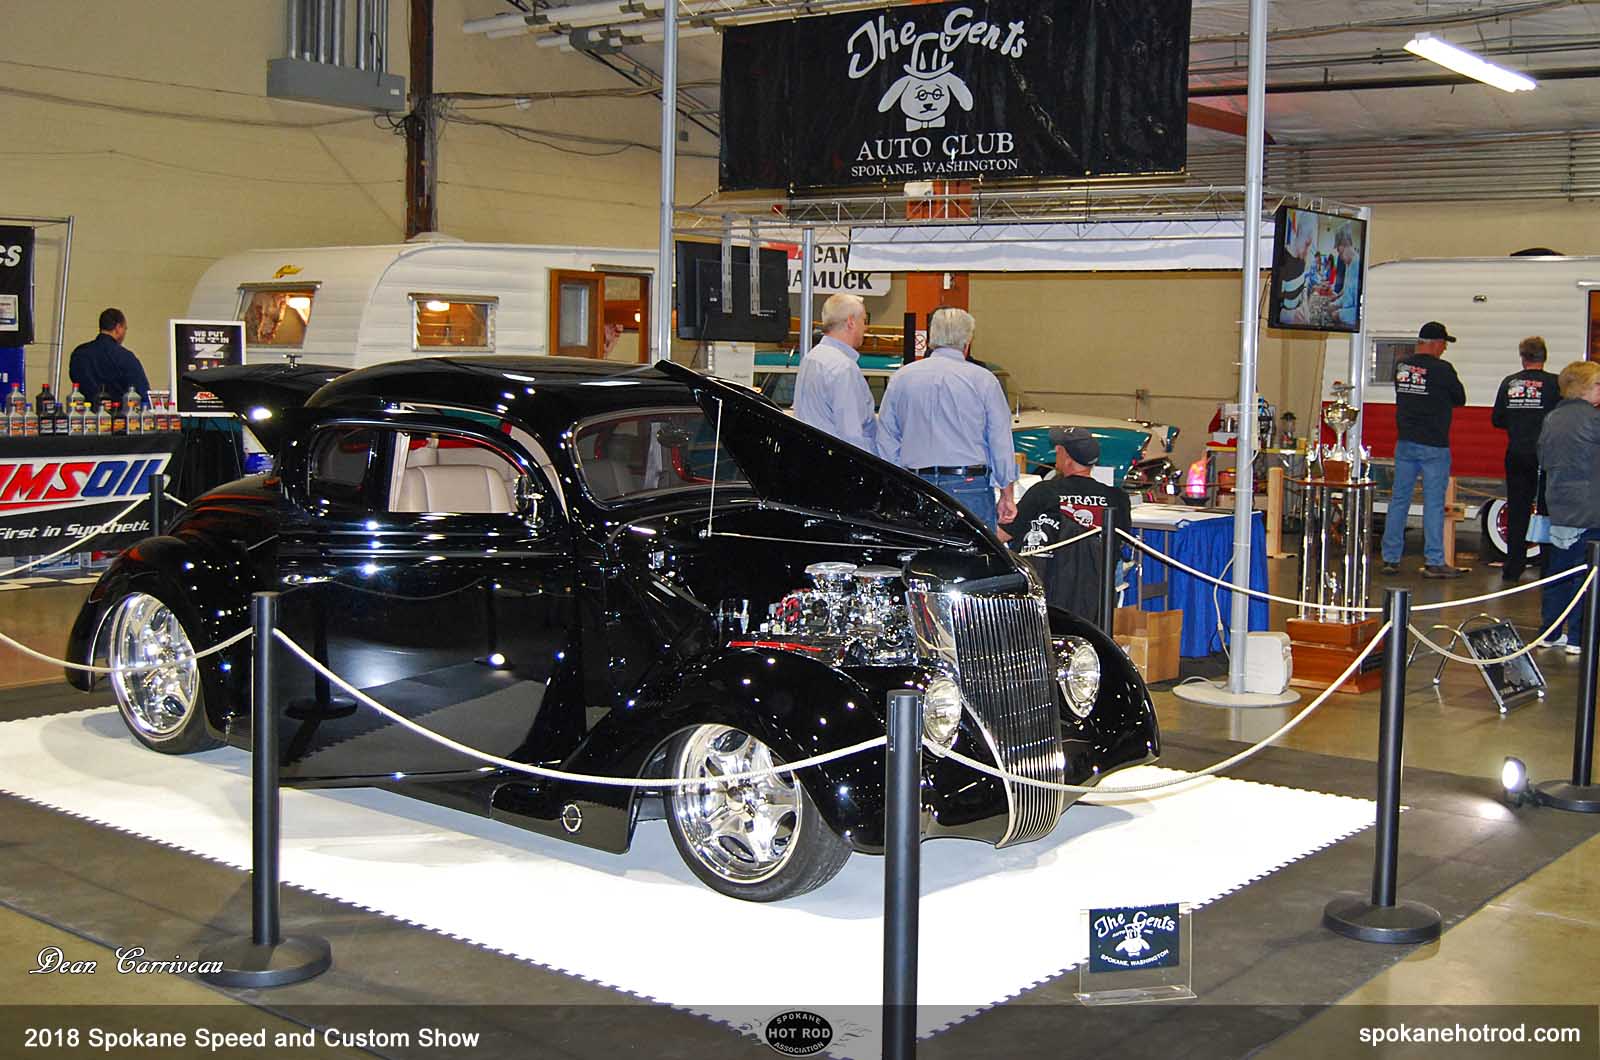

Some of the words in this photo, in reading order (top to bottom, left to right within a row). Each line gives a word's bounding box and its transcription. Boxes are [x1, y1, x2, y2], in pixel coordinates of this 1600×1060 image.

[847, 15, 916, 79] The
[939, 7, 1028, 58] Gents
[856, 136, 931, 161] AUTO
[942, 132, 1015, 161] CLUB
[851, 162, 918, 177] SPOKANE,
[922, 158, 1019, 174] WASHINGTON
[1059, 495, 1108, 506] PIRATE
[42, 525, 62, 537] in
[1094, 913, 1126, 938] The
[1133, 911, 1176, 932] Gents
[1130, 949, 1169, 966] WASHINGTON
